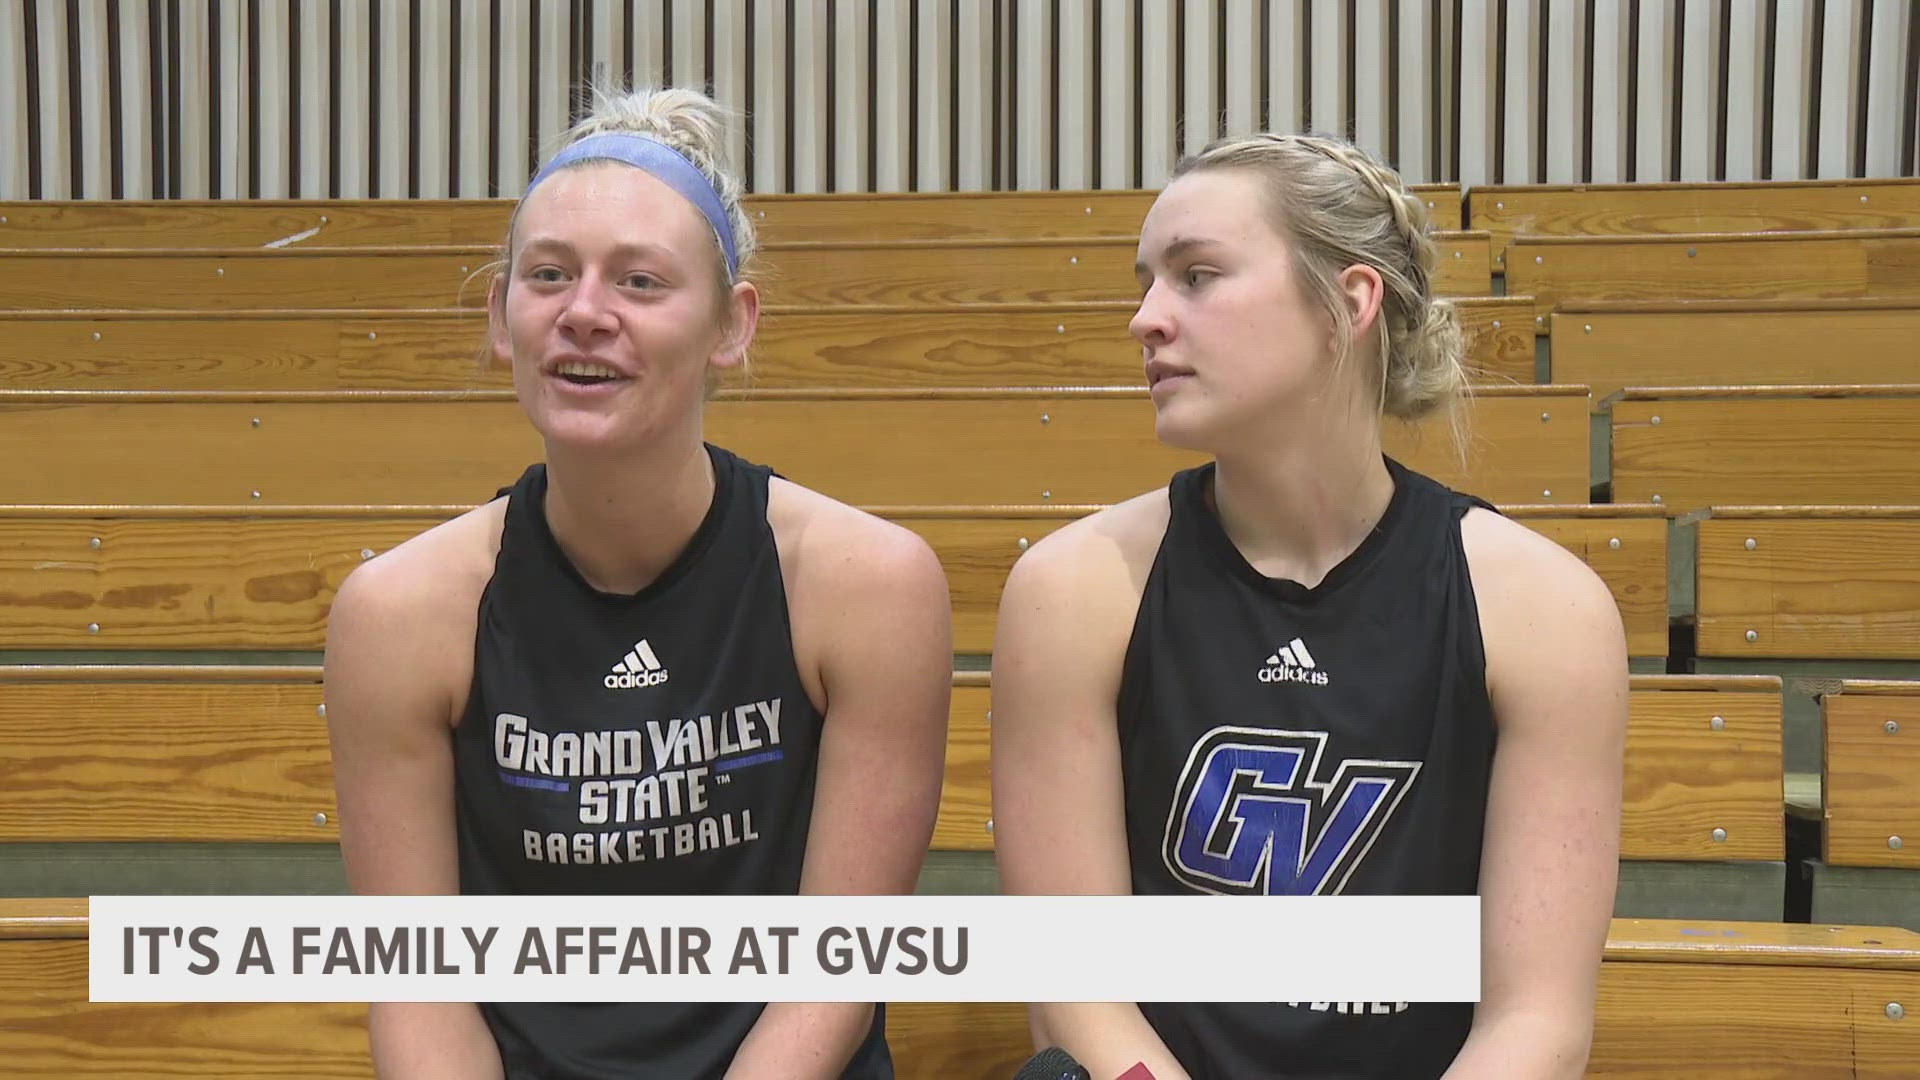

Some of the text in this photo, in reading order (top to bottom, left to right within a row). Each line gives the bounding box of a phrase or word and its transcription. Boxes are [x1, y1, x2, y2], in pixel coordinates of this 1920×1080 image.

[604, 668, 669, 688] adidas
[579, 766, 709, 824] STATE
[1161, 725, 1422, 896] GV
[523, 809, 759, 865] BASKETBALL
